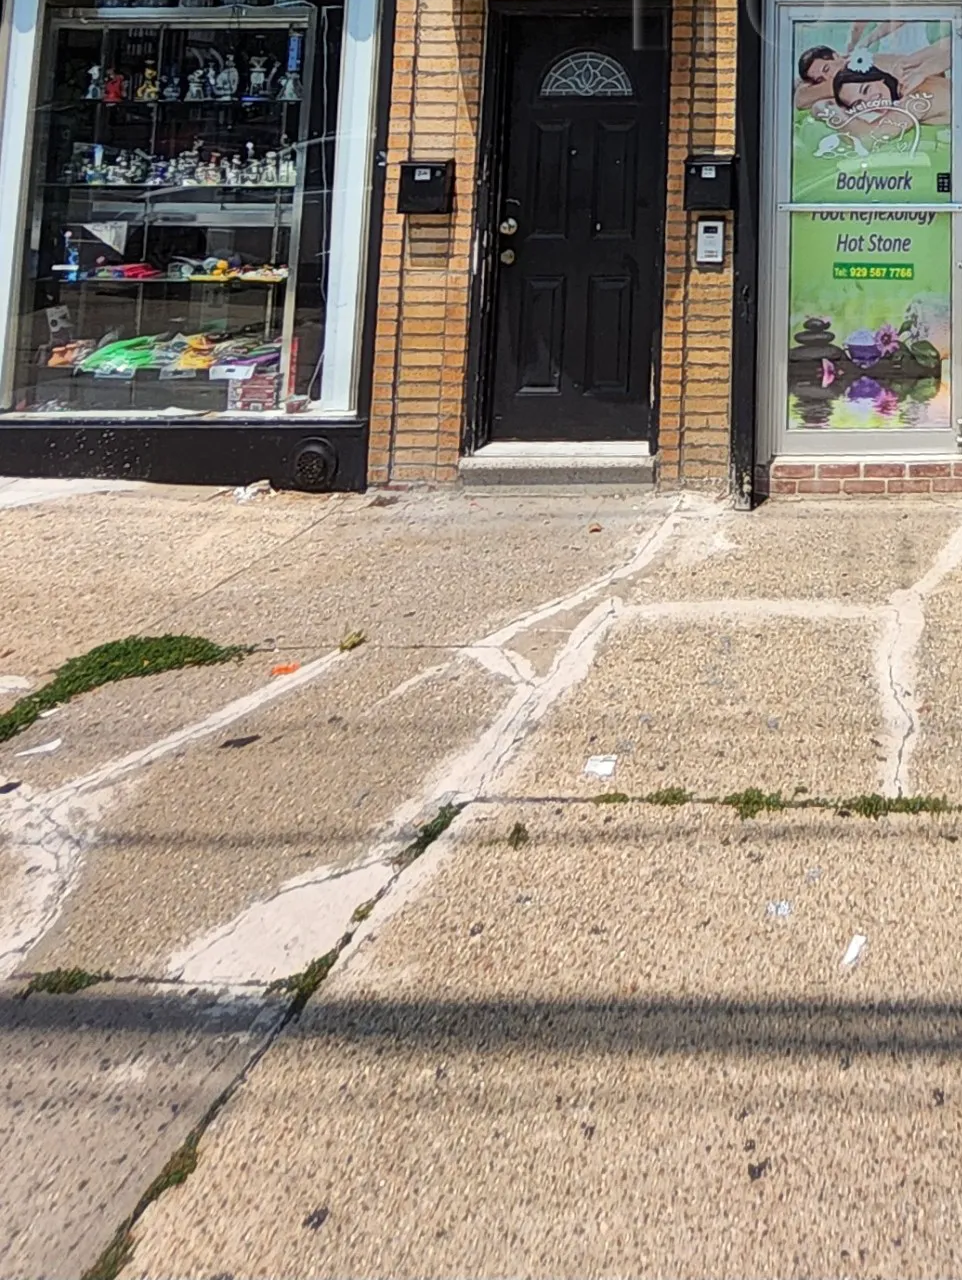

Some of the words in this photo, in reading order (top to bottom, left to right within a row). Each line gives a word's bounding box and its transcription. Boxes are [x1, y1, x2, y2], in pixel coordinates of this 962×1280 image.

[844, 98, 901, 116] welcome
[836, 170, 913, 195] Bodywork
[836, 233, 865, 253] Hot
[867, 233, 912, 253] Stone
[849, 267, 868, 278] 929
[869, 267, 887, 278] 567
[889, 267, 912, 278] 7766
